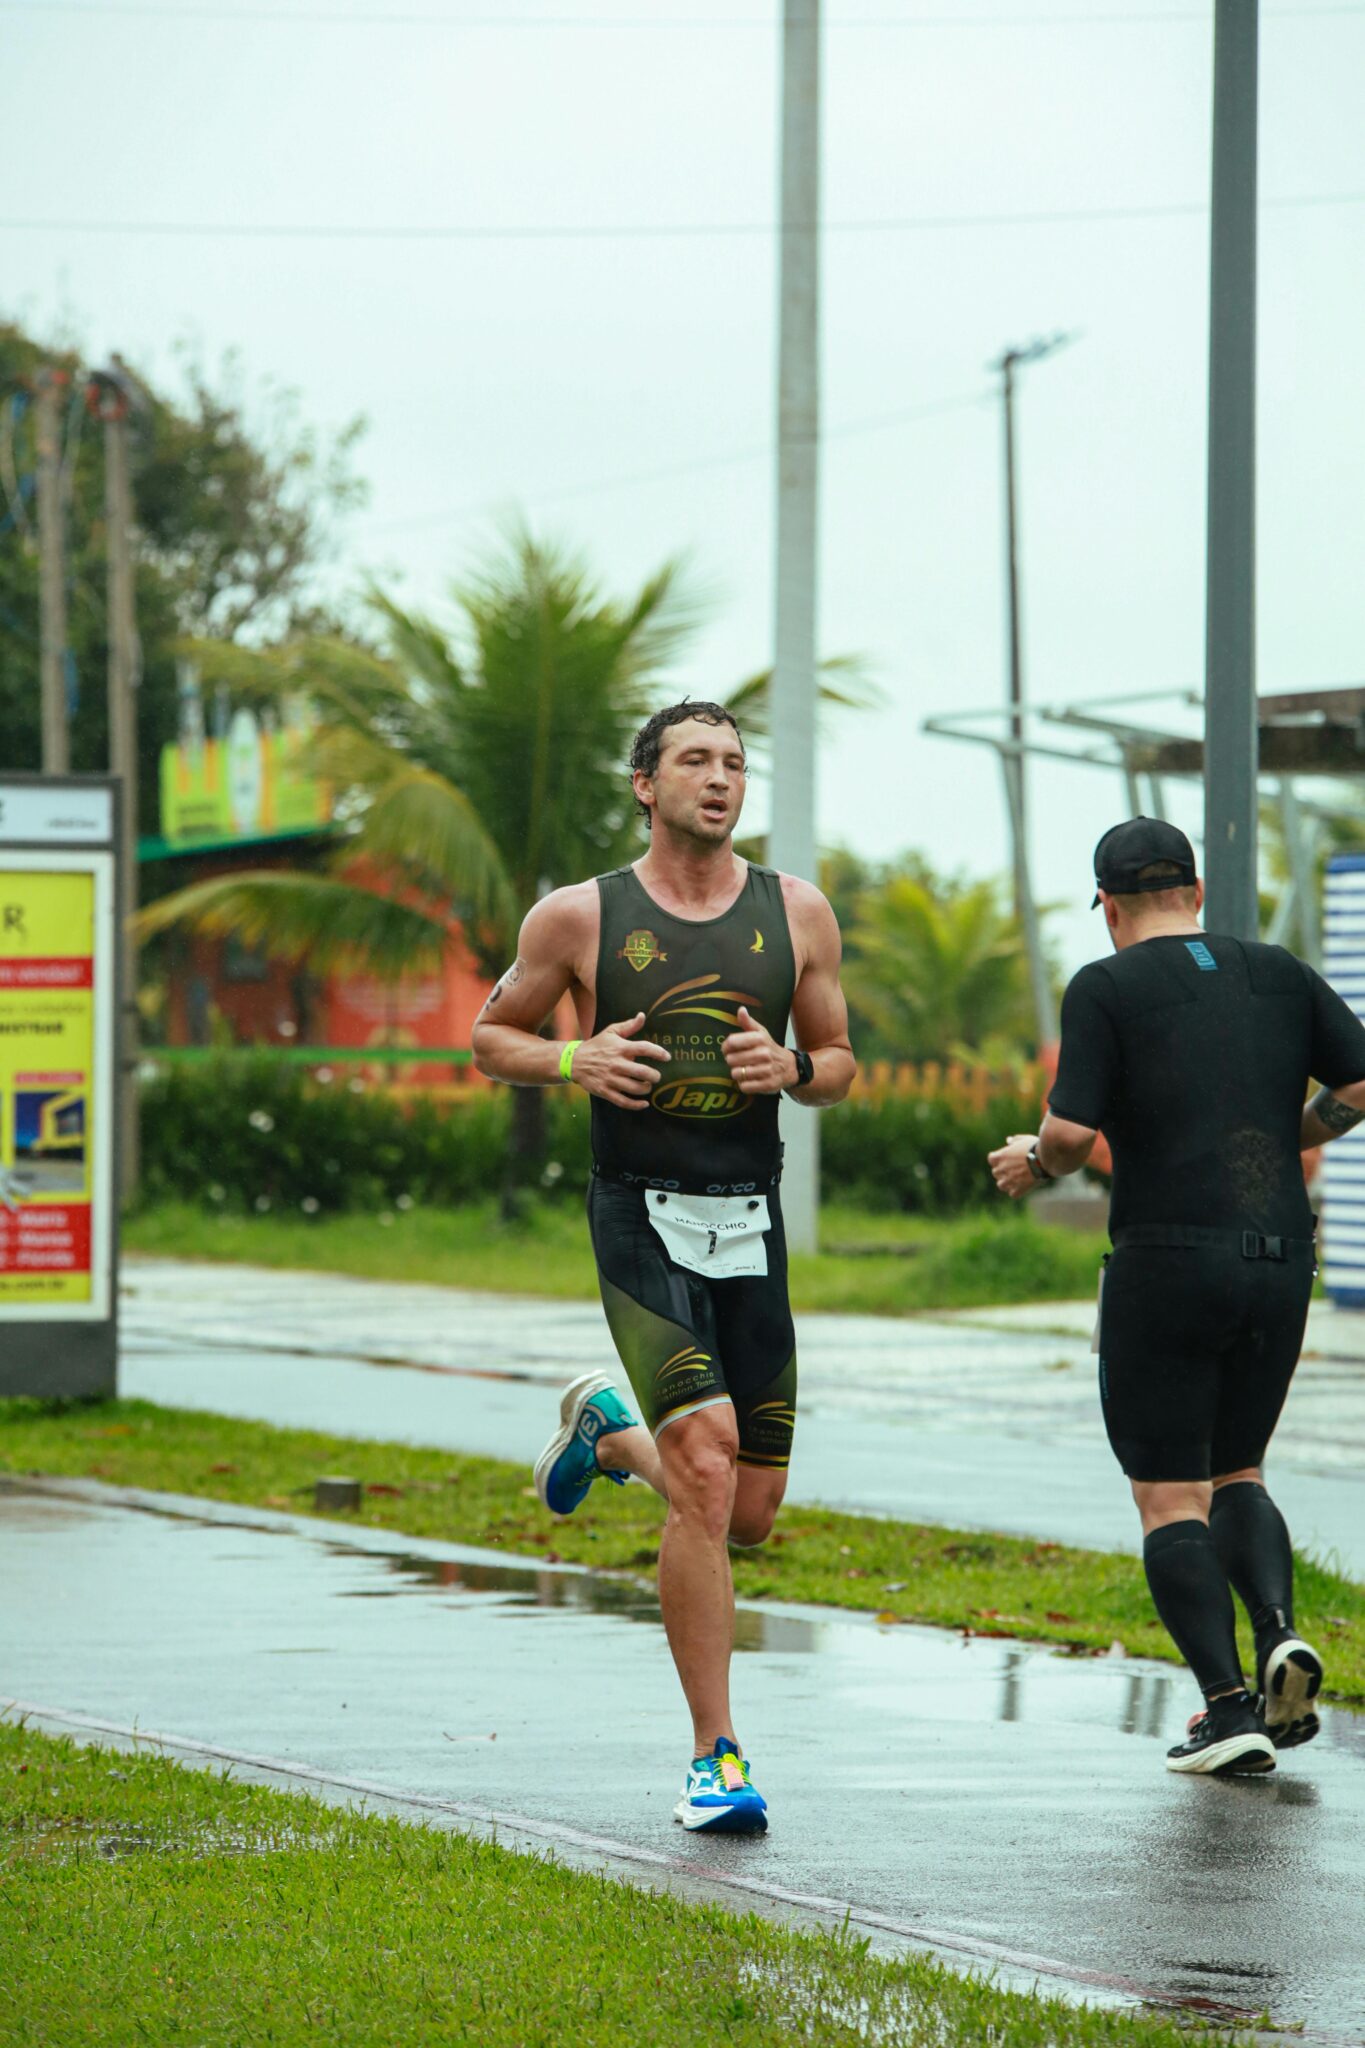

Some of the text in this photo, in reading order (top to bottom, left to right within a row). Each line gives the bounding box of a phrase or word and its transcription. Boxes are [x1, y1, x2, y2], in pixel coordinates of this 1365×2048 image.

[633, 937, 647, 950] 15
[645, 1032, 727, 1046] Manocc
[674, 1049, 716, 1061] thlon
[662, 1086, 740, 1112] Japi
[706, 1181, 757, 1194] orca
